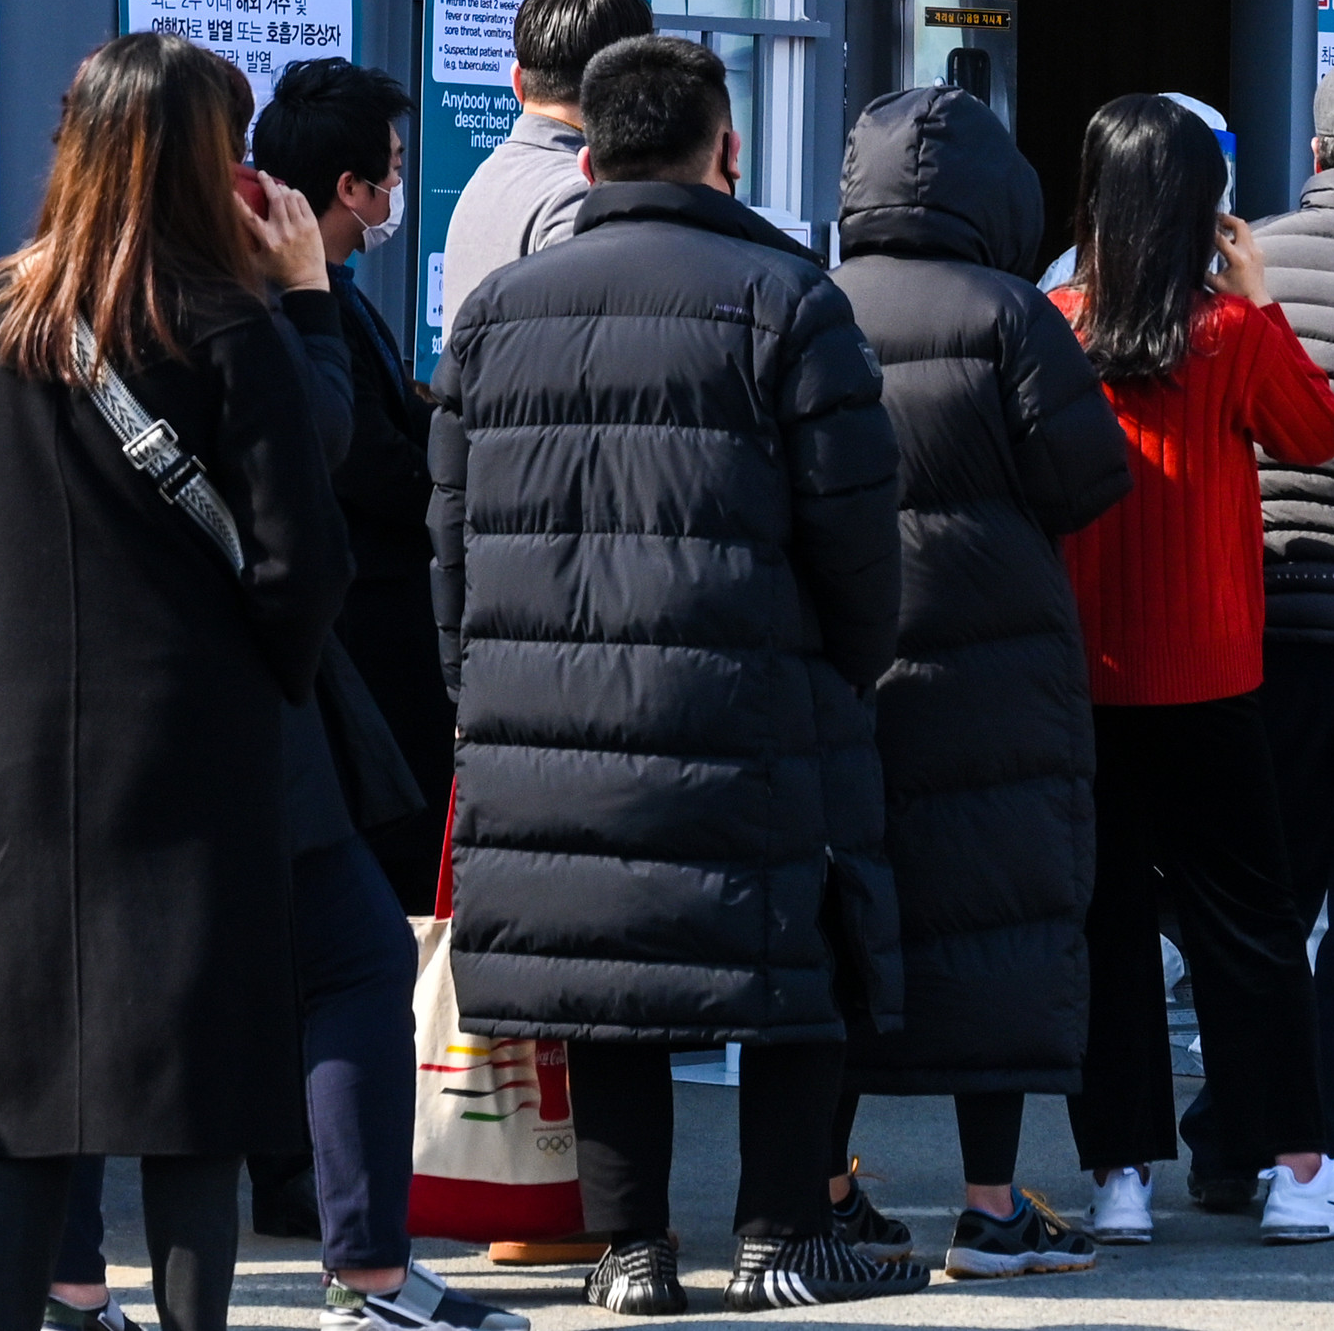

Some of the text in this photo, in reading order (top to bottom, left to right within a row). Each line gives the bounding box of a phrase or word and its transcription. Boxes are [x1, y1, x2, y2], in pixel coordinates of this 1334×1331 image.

[493, 0, 499, 9] 2
[445, 10, 508, 25] fever or respiratory
[208, 20, 233, 41] 발열
[237, 21, 263, 43] 또는
[266, 22, 341, 47] 호흡기증상자
[444, 27, 458, 36] sore
[458, 26, 482, 38] throat,
[444, 45, 478, 58] Suspected
[479, 47, 503, 58] patient
[247, 51, 274, 75] 발열,
[458, 60, 500, 72] tuberculosis)
[441, 90, 516, 111] Anybody who
[454, 111, 510, 130] described
